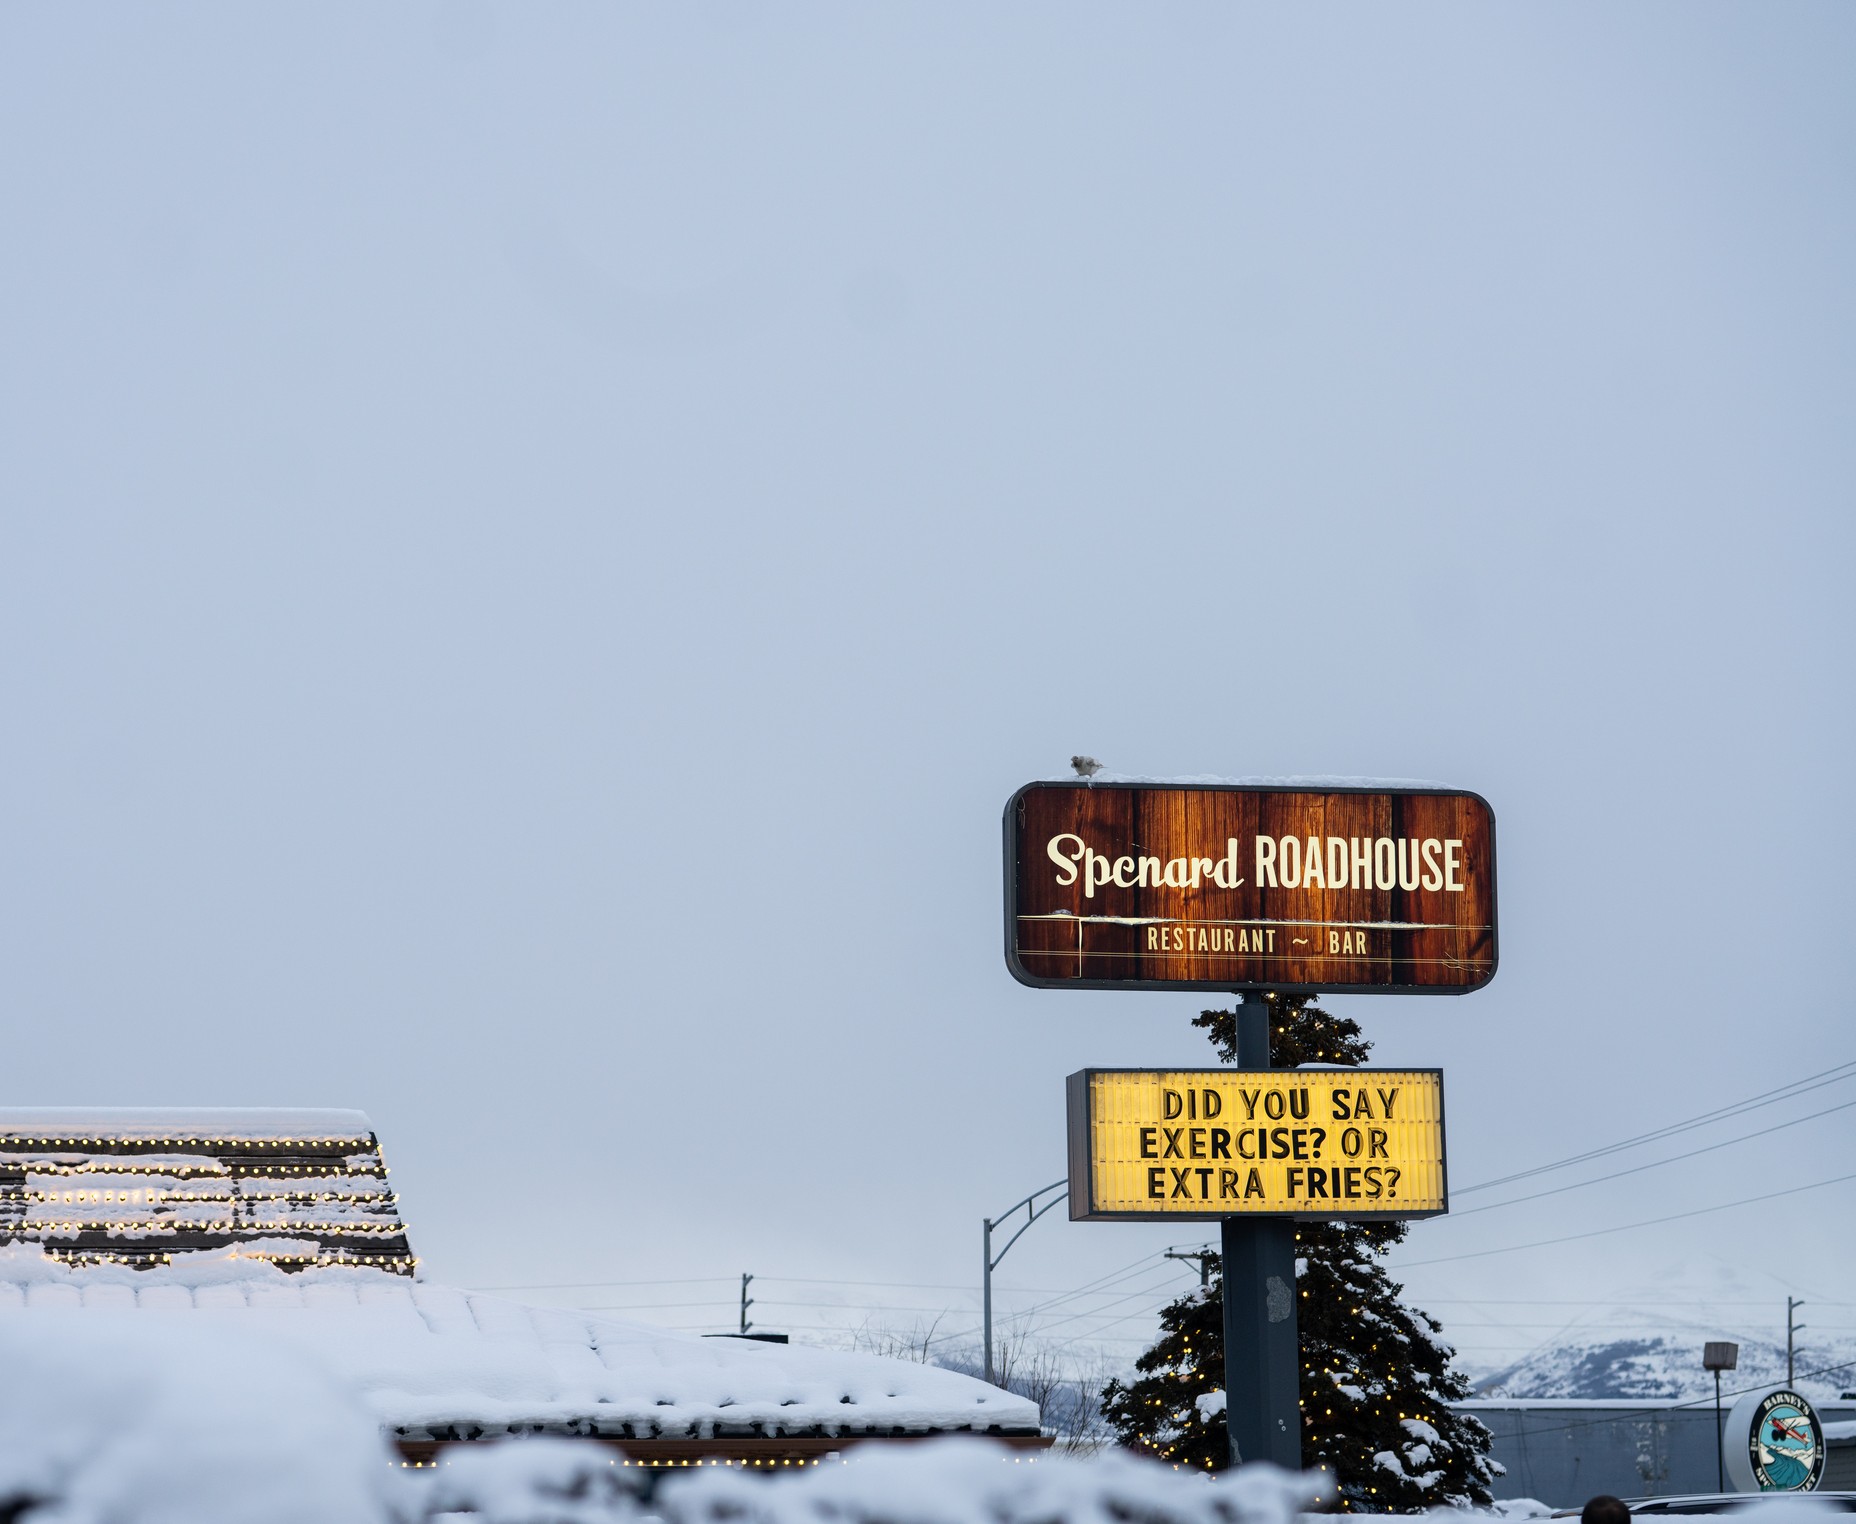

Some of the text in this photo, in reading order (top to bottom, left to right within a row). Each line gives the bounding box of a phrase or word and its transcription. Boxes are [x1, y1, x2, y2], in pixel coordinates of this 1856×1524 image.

[1047, 833, 1464, 898] Spenard ROADHOUSE
[1147, 927, 1276, 953] RESTAURANT
[1329, 930, 1367, 955] BAR
[1162, 1087, 1400, 1121] DID YOU SAY
[1139, 1127, 1389, 1160] EXERCISE? OR
[1148, 1166, 1402, 1199] EXTRA FRIES?
[1763, 1394, 1810, 1416] BARNEY'S
